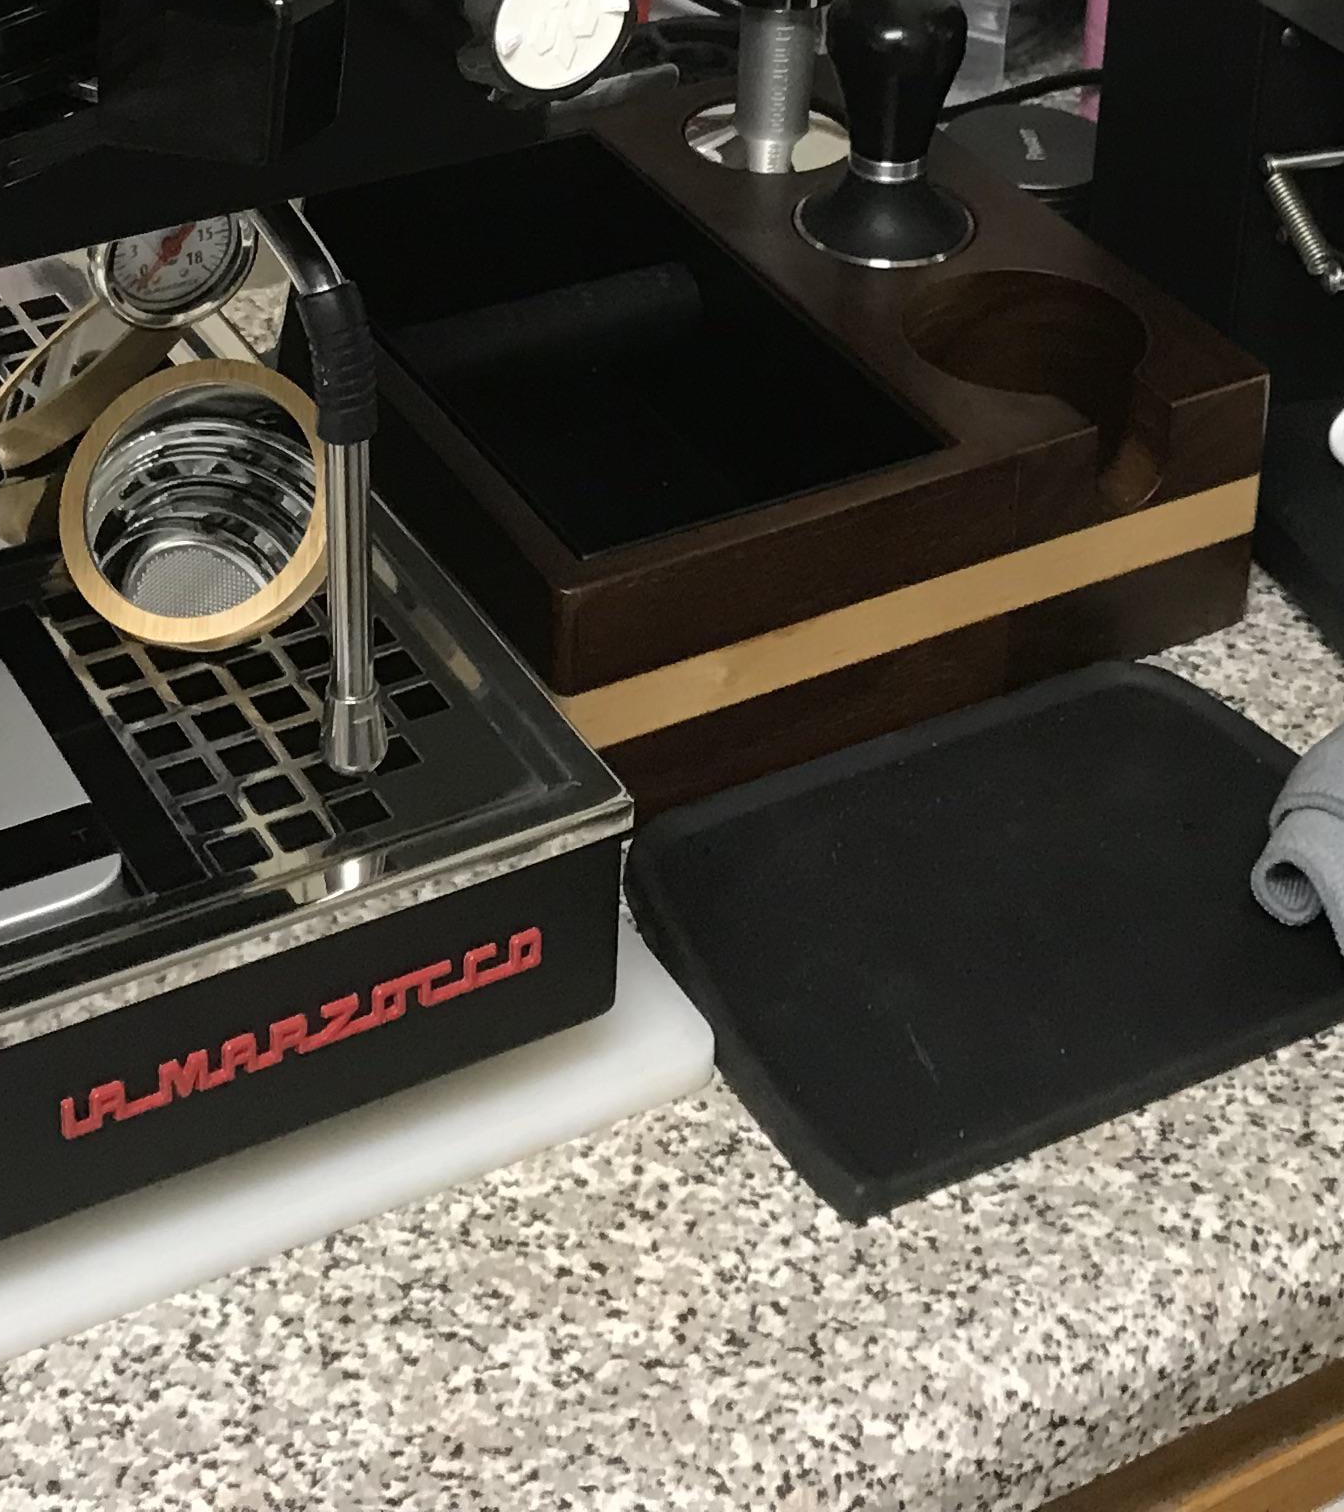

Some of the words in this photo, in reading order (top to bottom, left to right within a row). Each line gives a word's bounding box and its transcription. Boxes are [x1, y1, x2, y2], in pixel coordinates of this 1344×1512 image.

[197, 227, 214, 243] 15
[129, 244, 139, 258] 3
[186, 251, 204, 266] 18
